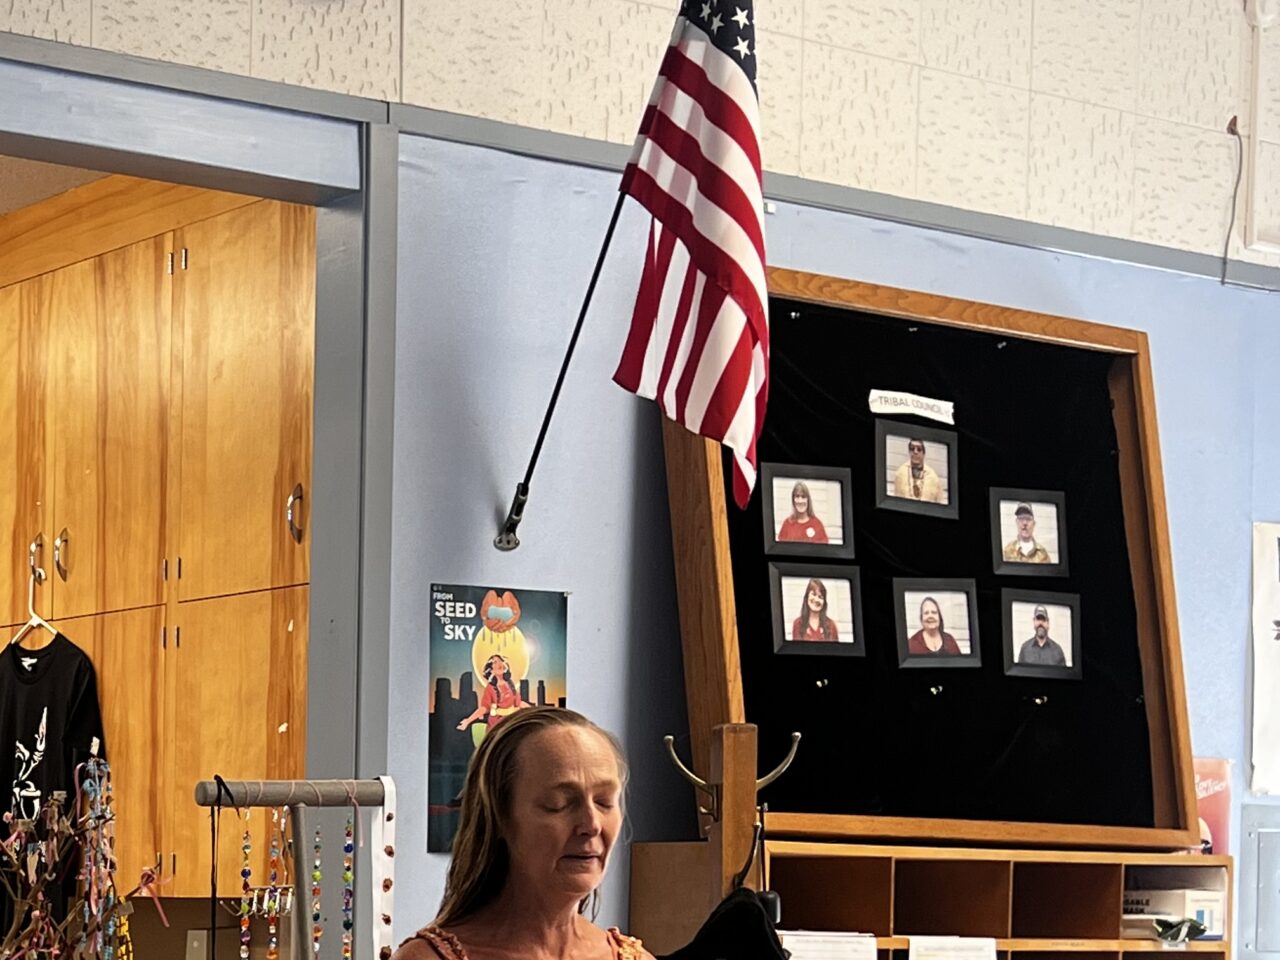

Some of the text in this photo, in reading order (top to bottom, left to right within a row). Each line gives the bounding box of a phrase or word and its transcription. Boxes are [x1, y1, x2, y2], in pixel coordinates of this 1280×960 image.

[879, 396, 910, 406] TRIBAL
[433, 592, 453, 600] FROM
[435, 601, 476, 617] SEED
[444, 624, 476, 640] SKY
